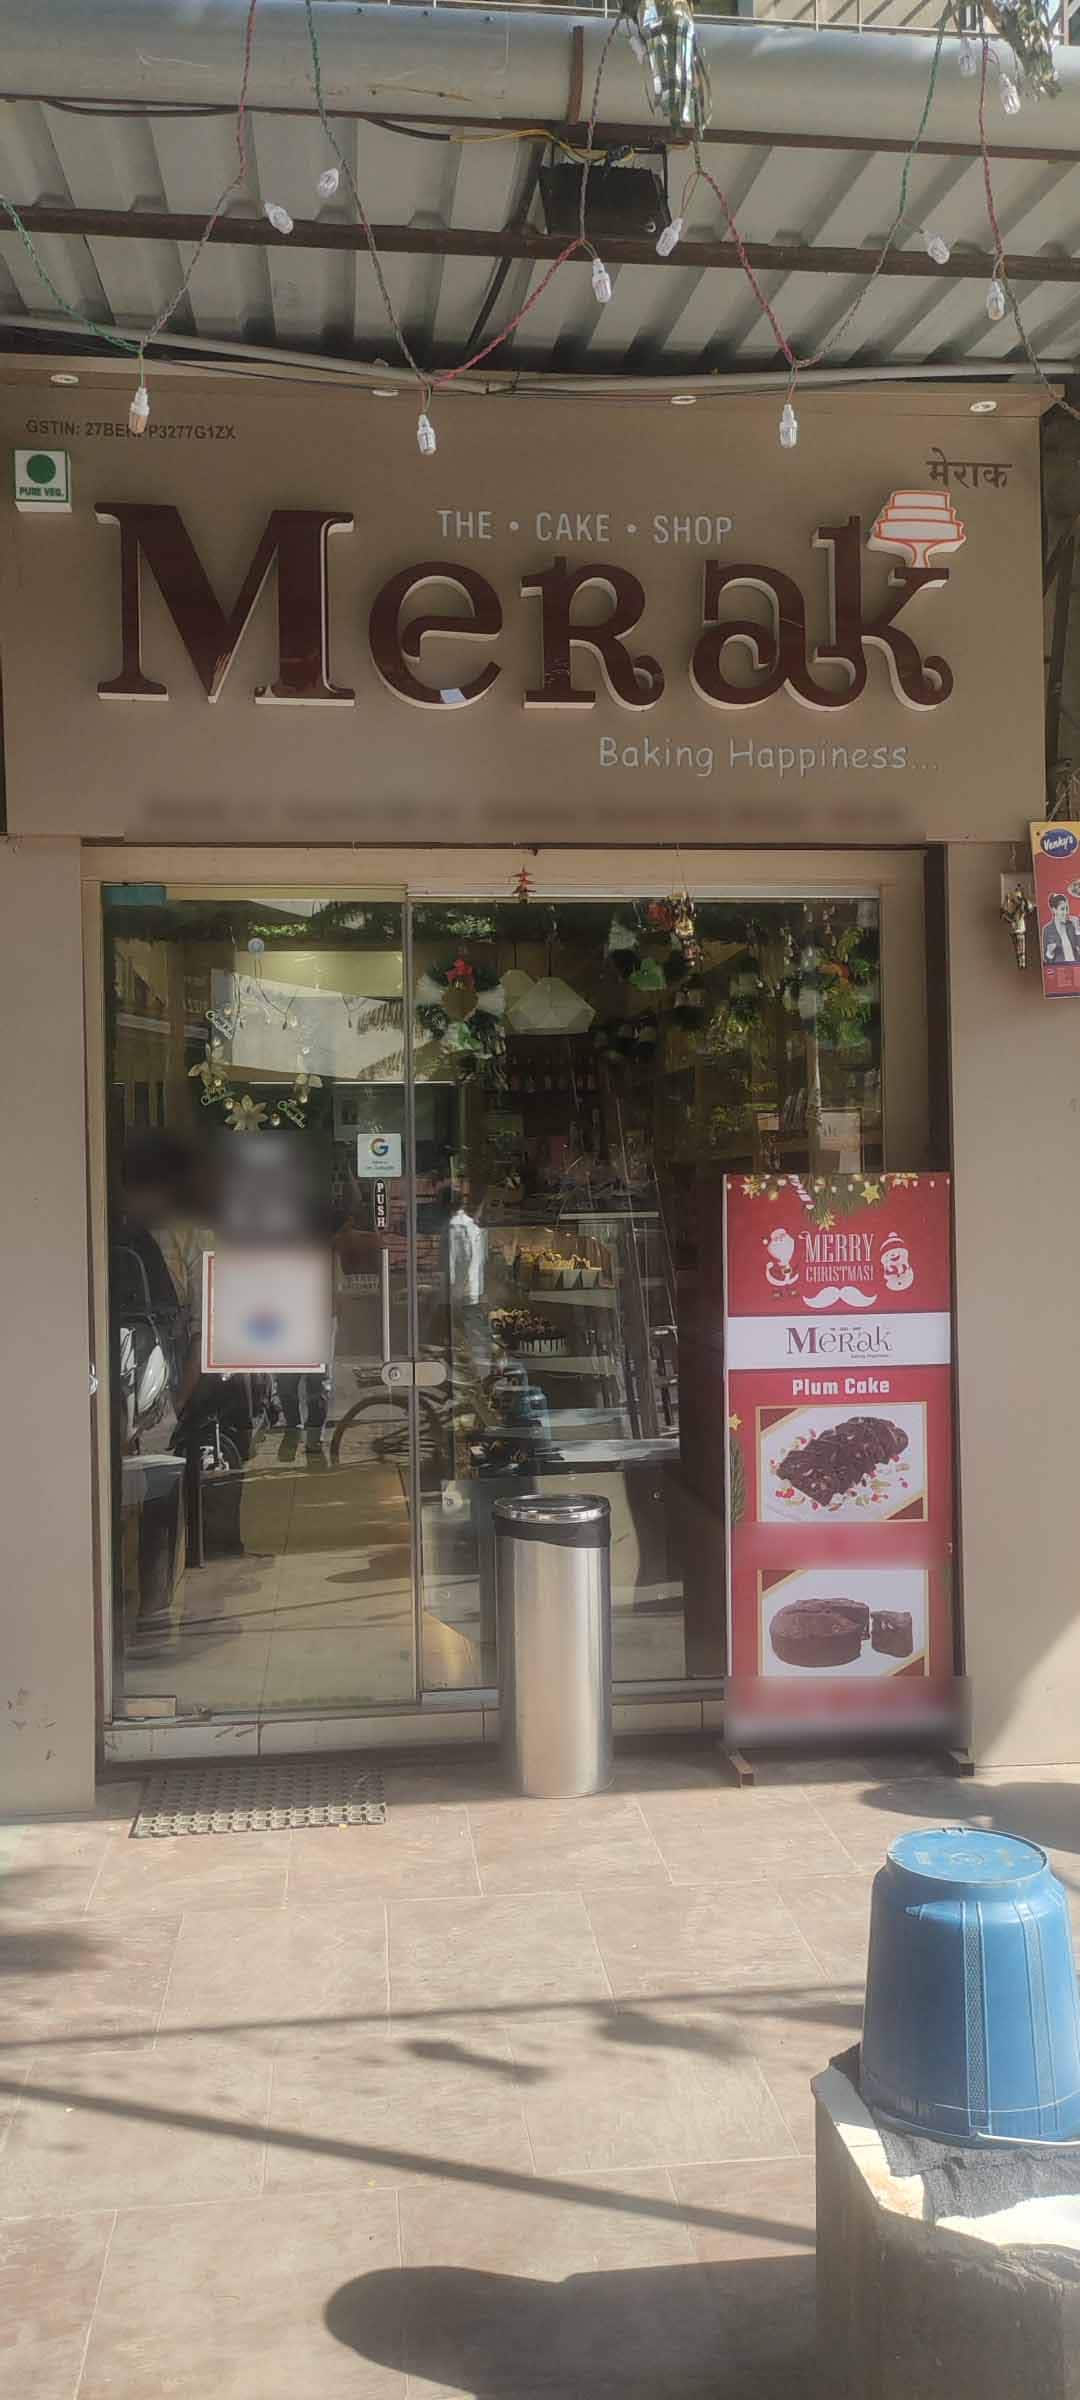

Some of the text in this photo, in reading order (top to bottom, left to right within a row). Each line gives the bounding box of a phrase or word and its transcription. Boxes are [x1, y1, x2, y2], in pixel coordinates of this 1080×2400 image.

[26, 420, 80, 436] GSTIN:
[926, 447, 1013, 488] मेराक
[19, 487, 42, 497] PURE
[437, 509, 732, 545] THE CAKE SHOP
[598, 736, 714, 777] Baking
[376, 1182, 386, 1228] PUSH
[798, 1230, 875, 1263] MERRY
[806, 1264, 875, 1283] CHRISTMAS!
[792, 1376, 890, 1396] Plum Cake
